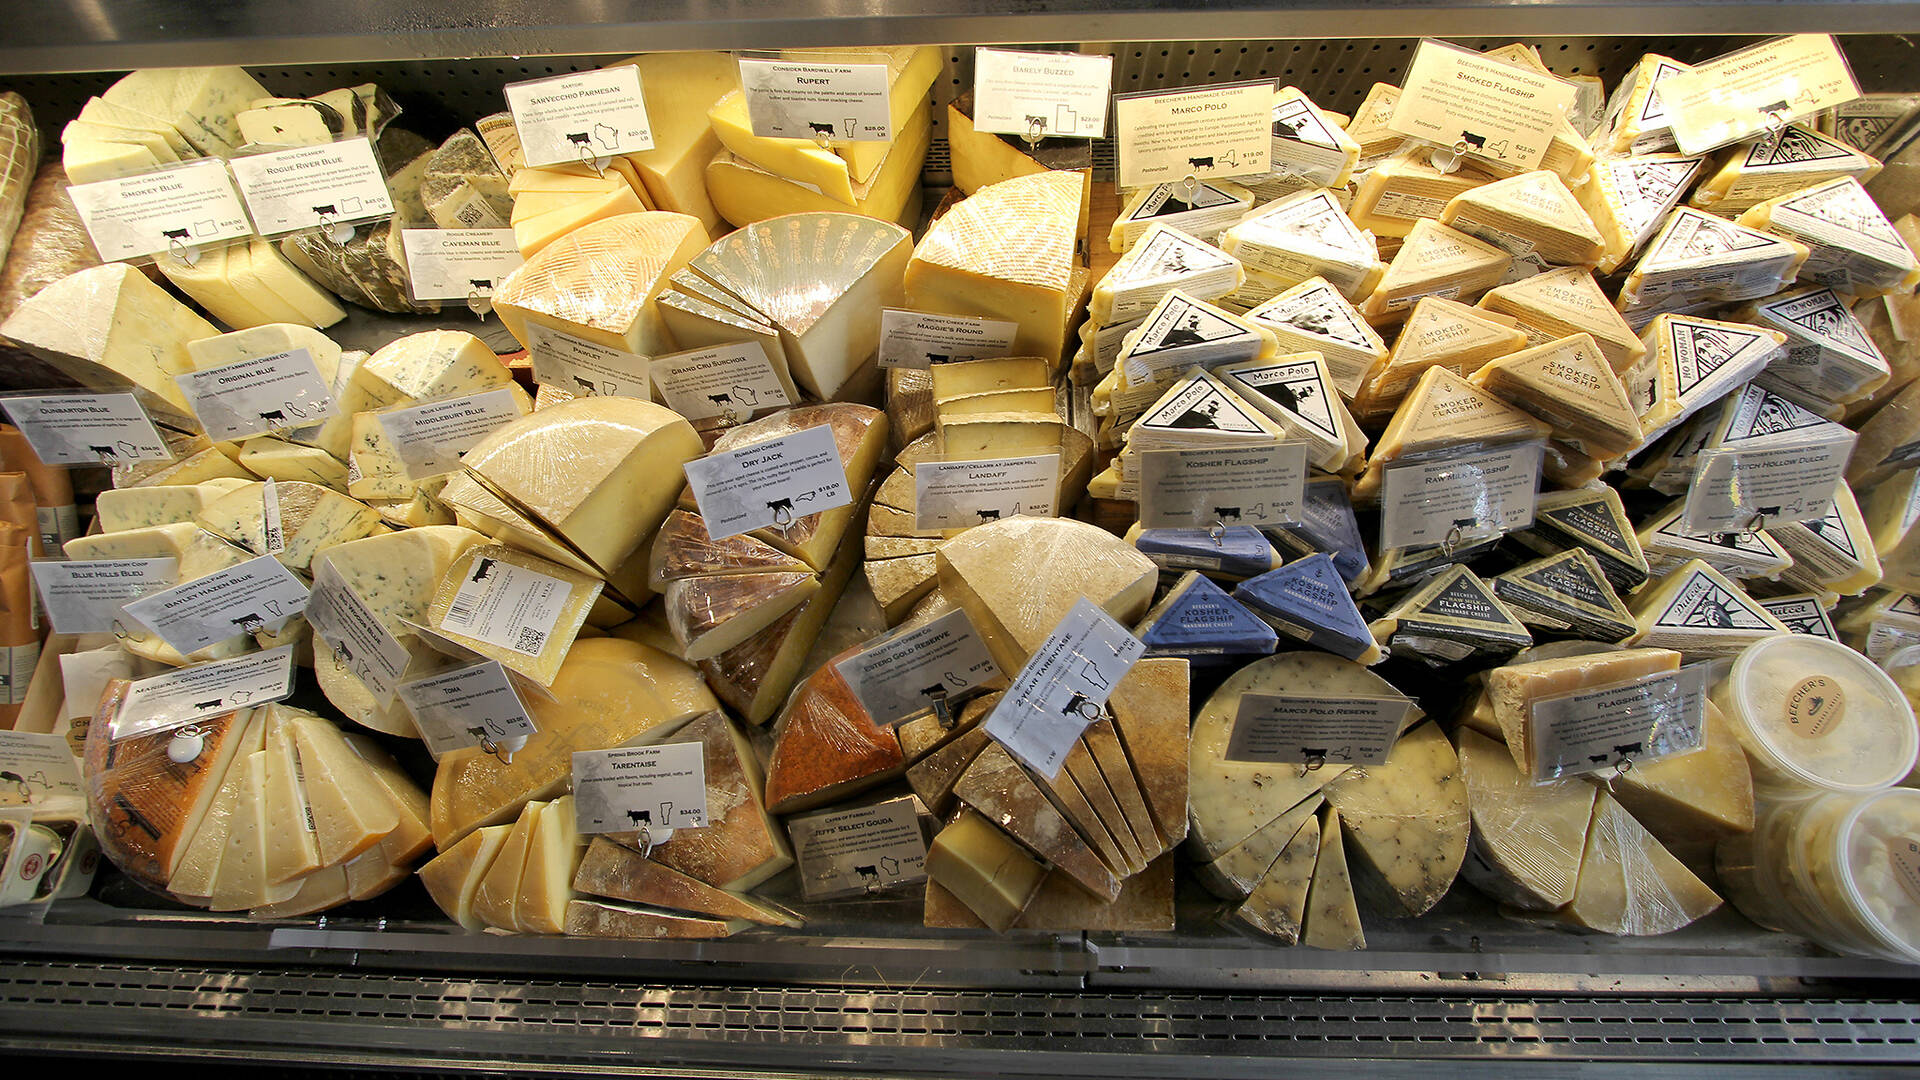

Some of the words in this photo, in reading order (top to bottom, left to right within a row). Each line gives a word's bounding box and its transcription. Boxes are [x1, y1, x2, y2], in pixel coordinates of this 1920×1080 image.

[1769, 38, 1795, 50] CHEESE
[1013, 66, 1041, 74] BARELY
[1044, 68, 1075, 76] BUZZED
[1456, 59, 1489, 72] BEECHER'S
[1490, 68, 1522, 82] HANDMADE
[1522, 77, 1545, 88] CHEESE
[1723, 68, 1738, 77] NO
[1738, 55, 1778, 72] WOMAN
[797, 77, 830, 85] RUPERT
[1456, 71, 1494, 88] SMOKED
[1494, 82, 1535, 100] FLAGSHIP
[530, 92, 578, 105] SARVECCHIO
[579, 86, 620, 98] PARMESAN
[1154, 96, 1187, 104] BEECHER'S
[1187, 93, 1220, 101] HANDMADE
[1221, 89, 1244, 97] CHEESE
[1171, 107, 1203, 115] MARCO
[1204, 103, 1228, 111] POLO
[267, 166, 295, 175] ROGUE
[296, 160, 321, 169] RIVER
[323, 157, 343, 165] BLUE
[1142, 166, 1169, 174] Pasteurized
[121, 187, 158, 199] SMOKEY
[160, 183, 184, 192] BLUE
[1145, 190, 1165, 212] Marco
[1802, 201, 1817, 209] NO
[1416, 248, 1467, 264] FLAGSHIP
[1417, 244, 1461, 257] SMOKED
[1539, 288, 1596, 311] FLAGSHIP
[1545, 284, 1594, 304] SMOKED
[1785, 305, 1798, 315] NO
[1799, 296, 1830, 309] WOMAN
[917, 323, 954, 332] MAGGIE'S
[956, 327, 983, 335] ROUND
[1146, 320, 1167, 346] Marco
[1165, 303, 1180, 323] Polo
[1419, 323, 1464, 340] SMOKED
[1417, 327, 1471, 347] FLAGSHIP
[1677, 329, 1688, 363] WOMAN
[259, 356, 280, 365] CHEESE
[671, 366, 697, 376] GRAND
[697, 362, 712, 370] CRU
[713, 356, 746, 367] SURCHOIX
[218, 372, 255, 384] ORIGINAL
[256, 367, 276, 375] BLUE
[1253, 371, 1286, 382] Marco
[1287, 366, 1310, 375] Polo
[1541, 364, 1601, 391] FLAGSHIP
[1547, 360, 1599, 384] SMOKED
[1682, 366, 1691, 380] NO
[40, 407, 88, 415] DUNBARTON
[1161, 397, 1187, 421] Marco
[1185, 384, 1204, 400] Polo
[1432, 402, 1484, 418] FLAGSHIP
[1433, 397, 1477, 411] SMOKED
[415, 412, 464, 426] MIDDLEBURY
[464, 407, 486, 415] BLUE
[1735, 420, 1746, 433] NO
[1741, 390, 1759, 419] WOMAN
[734, 447, 761, 459] RUMIANO
[761, 441, 784, 451] CHEESE
[741, 458, 760, 469] DRY
[761, 452, 784, 464] JACK
[939, 463, 994, 471] LANDAFF/CELLARS
[1186, 460, 1222, 468] KOSHER
[1225, 458, 1269, 466] FLAGSHIP
[1424, 464, 1457, 473] BEECHER'S
[1489, 454, 1512, 463] CHEESE
[1731, 462, 1761, 471] DUTCH
[1762, 458, 1798, 468] HOLLOW
[1799, 454, 1830, 464] DULCET
[1425, 476, 1448, 484] RAW
[1448, 473, 1467, 481] MILK
[1567, 511, 1620, 541] FLAGSHIP
[211, 573, 229, 582] FARM
[1301, 575, 1329, 589] BEECHER'S
[1543, 572, 1598, 596] FLAGSHIP
[164, 594, 199, 609] BAYLEY
[201, 583, 230, 597] HAZEN
[229, 574, 254, 586] BLUE
[1283, 581, 1338, 607] FLAGSHIP
[1291, 576, 1336, 600] KOSHER
[1450, 591, 1479, 600] BEECHER'S
[1439, 600, 1491, 612] FLAGSHIP
[1674, 581, 1703, 616] Dulcet
[1184, 608, 1230, 616] KOSHER
[1439, 608, 1470, 616] HANDMADE
[1471, 611, 1491, 619] CHEESE
[1766, 603, 1807, 615] Dulcet
[1180, 615, 1235, 624] FLAGSHIP
[863, 658, 892, 672] ESTERO
[893, 648, 915, 660] GOLD
[915, 631, 951, 651] RESERVE
[1014, 673, 1030, 691] SPRING
[1029, 653, 1044, 672] BROOK
[1044, 635, 1057, 653] FARM
[135, 681, 179, 694] MARIEKE
[180, 672, 216, 684] GOUDA
[216, 662, 259, 675] PREMIUM
[261, 654, 287, 664] AGED
[460, 671, 477, 679] CHEESE
[443, 687, 462, 695] TOMA
[1016, 677, 1039, 708] 2-YEAR
[1574, 692, 1611, 702] BEECHER'S
[1597, 692, 1653, 710] FLAGSHEEP
[1789, 679, 1826, 725] BEECHER'S
[612, 761, 657, 770] TARENTAISE
[849, 810, 876, 819] FARIBAULT
[815, 827, 837, 837] JEFFS'
[838, 823, 864, 832] SELECT
[866, 818, 893, 828] GOUDA
